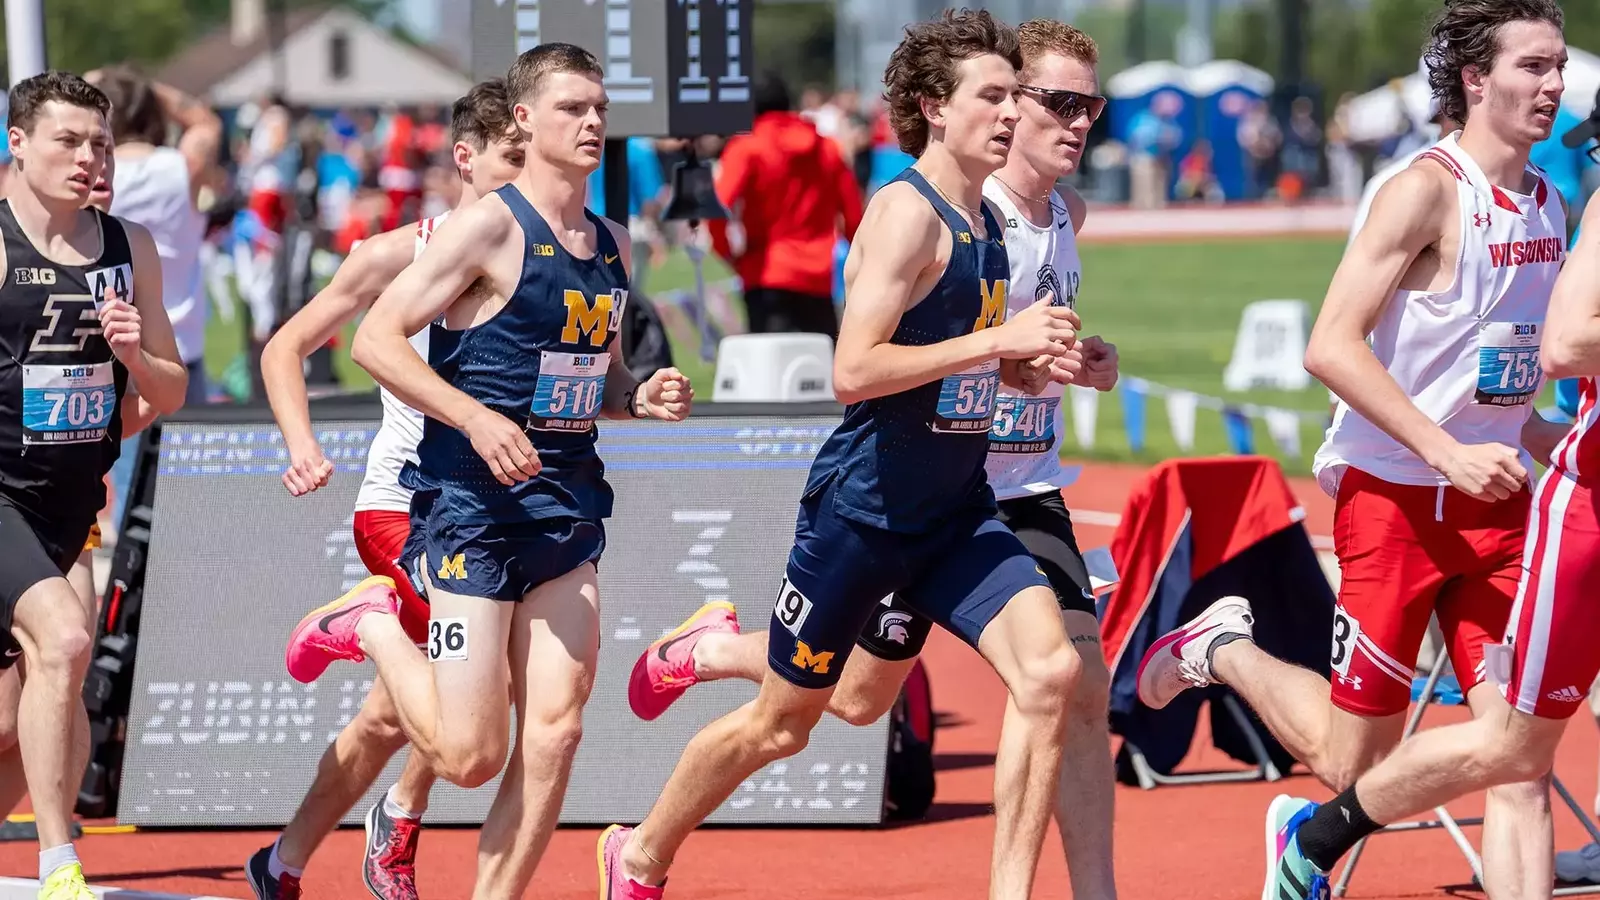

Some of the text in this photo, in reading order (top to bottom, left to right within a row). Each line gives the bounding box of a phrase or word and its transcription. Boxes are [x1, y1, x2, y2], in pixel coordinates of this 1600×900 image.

[94, 268, 129, 300] 44
[561, 289, 613, 346] M
[972, 279, 1008, 334] M
[1498, 351, 1540, 389] 753
[43, 390, 104, 426] 703
[549, 380, 597, 414] 510
[992, 402, 1047, 437] 540
[437, 553, 466, 579] M
[430, 621, 465, 660] 36
[791, 638, 836, 674] M
